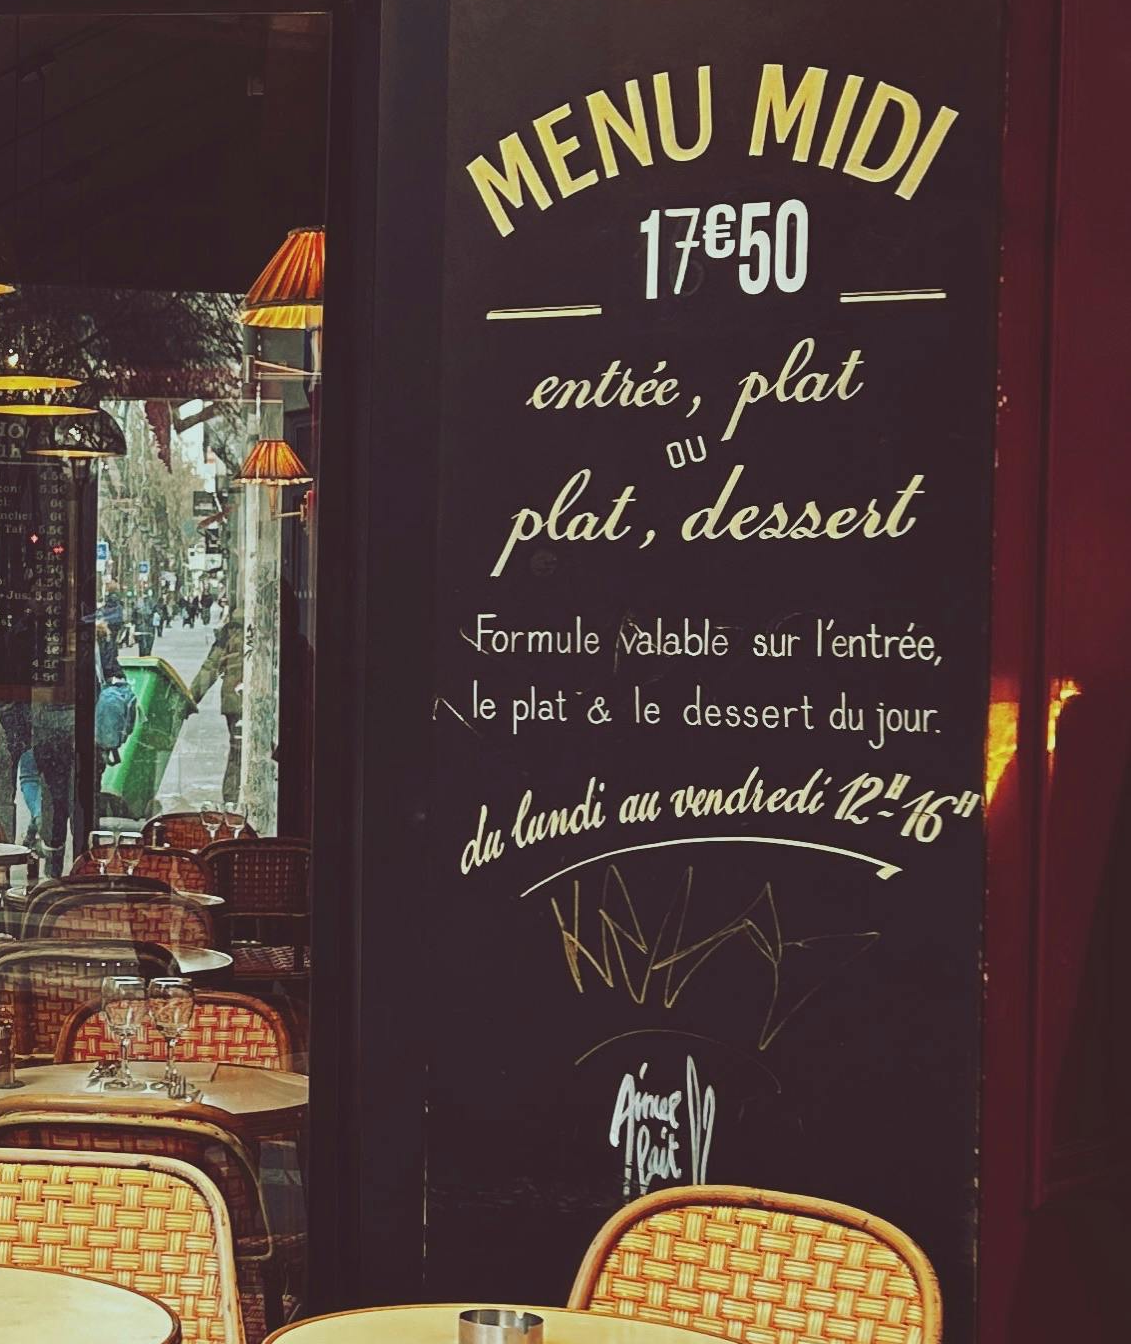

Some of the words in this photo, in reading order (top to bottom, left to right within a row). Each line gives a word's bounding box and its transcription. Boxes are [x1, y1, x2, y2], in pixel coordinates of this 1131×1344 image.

[466, 65, 713, 238] MENU
[749, 64, 959, 200] MIDI
[640, 199, 809, 300] 17€50
[721, 337, 865, 442] plat
[681, 465, 925, 542] dessert
[477, 613, 600, 654] Formule
[620, 617, 729, 656] valable
[753, 633, 801, 657] sur
[817, 618, 942, 666] l'entrée,
[473, 679, 497, 719] le
[513, 685, 568, 735] plat
[587, 696, 612, 724] &
[635, 685, 661, 724] le
[683, 684, 815, 730] dessert
[829, 691, 864, 731] du
[868, 702, 941, 749] jour.
[461, 805, 504, 874] du
[511, 776, 605, 848] lundi
[619, 789, 661, 824] au
[670, 766, 832, 817] vendredi
